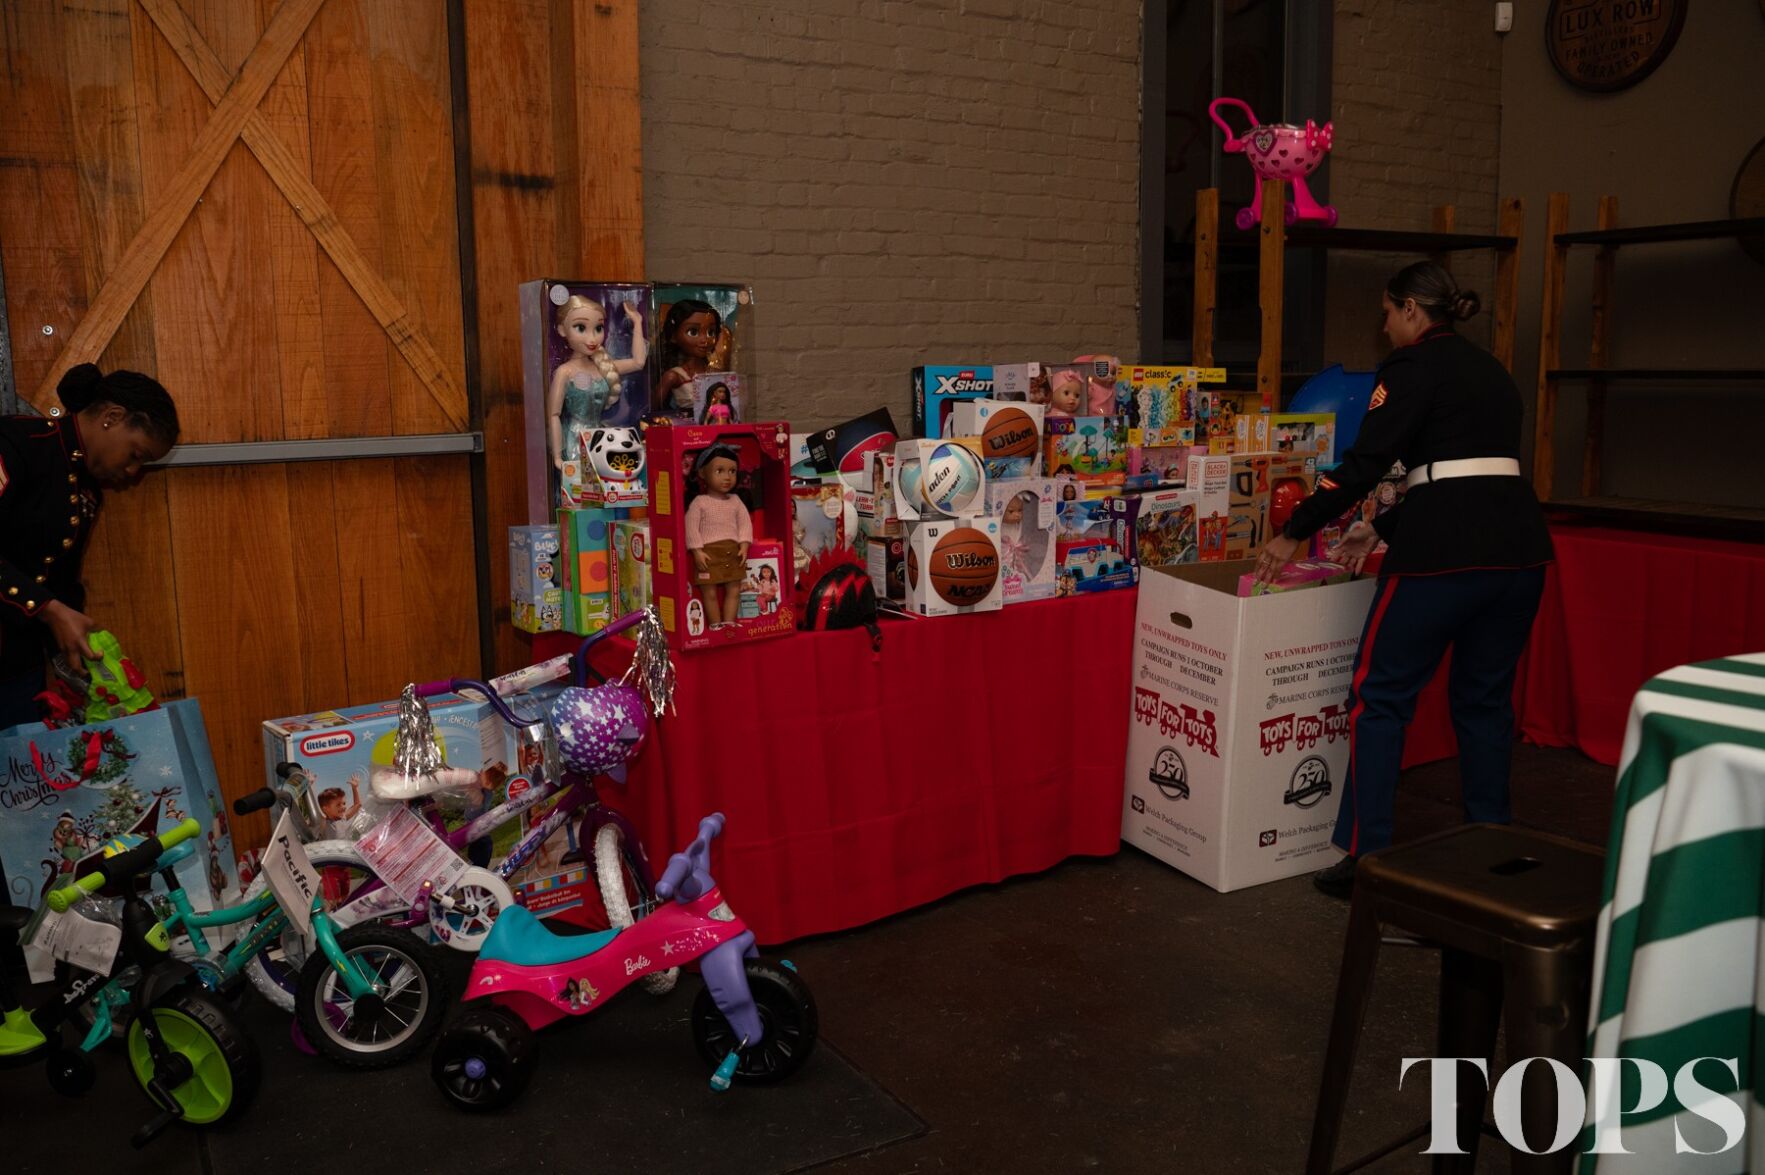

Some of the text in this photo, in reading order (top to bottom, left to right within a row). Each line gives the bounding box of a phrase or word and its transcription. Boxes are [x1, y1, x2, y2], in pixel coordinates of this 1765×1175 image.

[1566, 0, 1653, 33] LUX ROW
[1566, 32, 1653, 60] FAMILY OWNED
[1577, 51, 1639, 78] OPERATED
[1145, 370, 1172, 379] classic
[989, 427, 1034, 450] Wilson
[1151, 501, 1180, 511] Dinosaurs
[946, 553, 996, 569] Wilson
[748, 621, 793, 637] generation
[1154, 628, 1190, 648] UNWRAPPED
[1191, 643, 1208, 654] TOYS
[1208, 648, 1227, 661] ONLY
[1284, 643, 1329, 658] UNWRAPPED
[1329, 639, 1346, 650] TOYS
[1346, 637, 1359, 646] ONL
[1141, 639, 1169, 656] CAMPAIGN
[1170, 650, 1186, 662] RUNS
[1191, 659, 1223, 677] OCTOBER
[1145, 650, 1216, 686] THROUGH DECEMBER
[1265, 663, 1305, 676] CAMPAIGN
[1306, 658, 1325, 669] RUNS
[1272, 665, 1353, 686] THROUGH DECEMBE
[1149, 671, 1219, 706] MARINE CORPS RESERVE
[1279, 692, 1306, 704] MARINE
[1307, 687, 1329, 699] CORPS
[1136, 693, 1213, 746] TOYS FOR TOTS
[1262, 720, 1291, 743] TOYS
[1297, 720, 1320, 737] FOR
[306, 736, 349, 751] little tikes
[0, 752, 63, 788] Mery
[1160, 760, 1183, 780] 250
[1298, 769, 1325, 788] 250
[1145, 805, 1161, 819] Welch
[1161, 812, 1188, 834] Packaging
[1188, 827, 1206, 843] Group
[1279, 828, 1297, 838] Welch
[1299, 821, 1329, 834] Packaging
[278, 834, 312, 899] Pacific
[624, 955, 652, 976] Barbie
